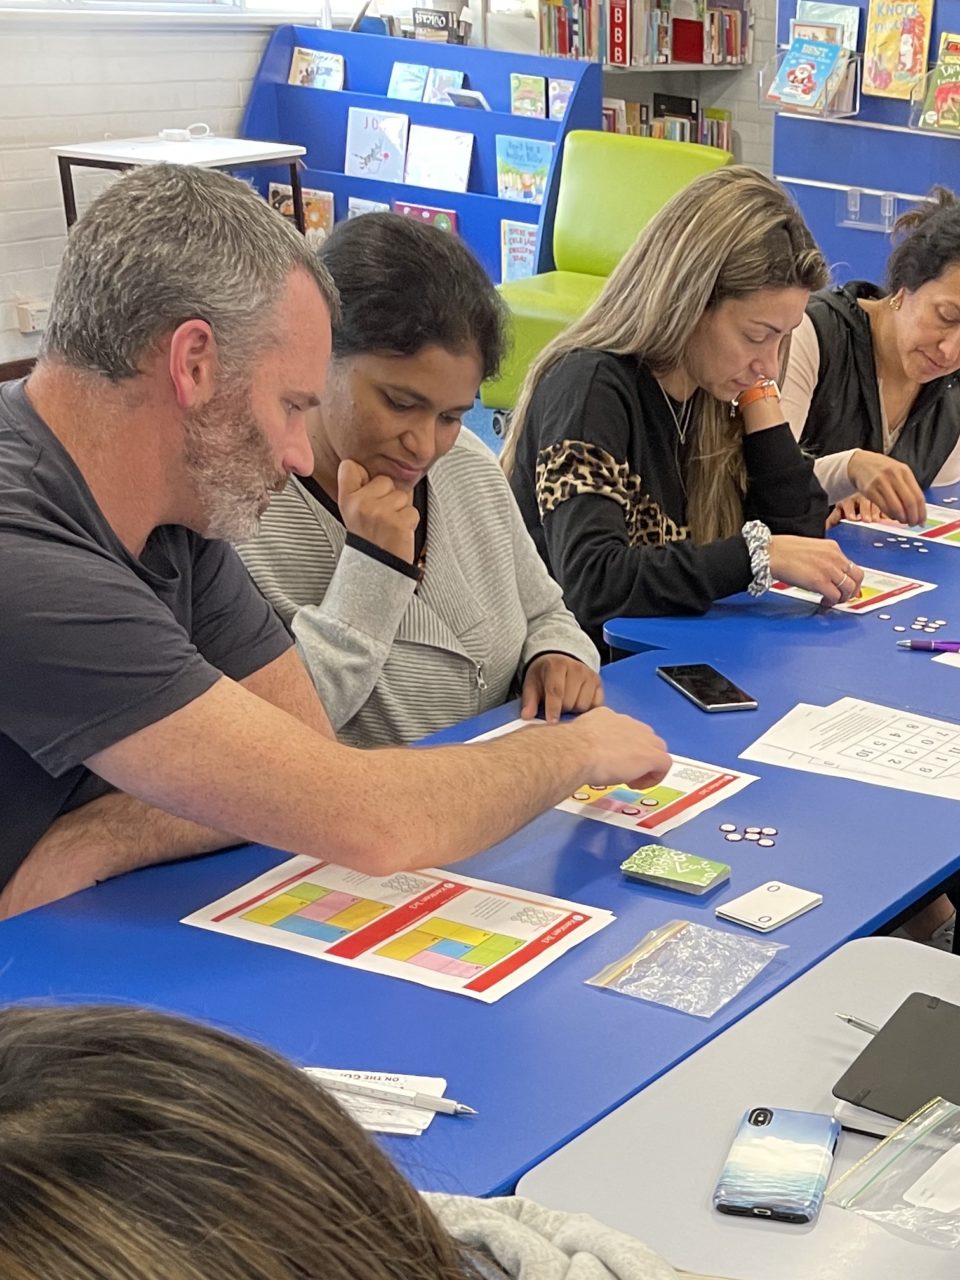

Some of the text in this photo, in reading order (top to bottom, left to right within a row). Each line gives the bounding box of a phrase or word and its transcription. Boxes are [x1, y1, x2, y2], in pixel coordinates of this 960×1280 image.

[614, 7, 623, 23] B
[614, 27, 623, 43] B
[614, 47, 623, 62] B
